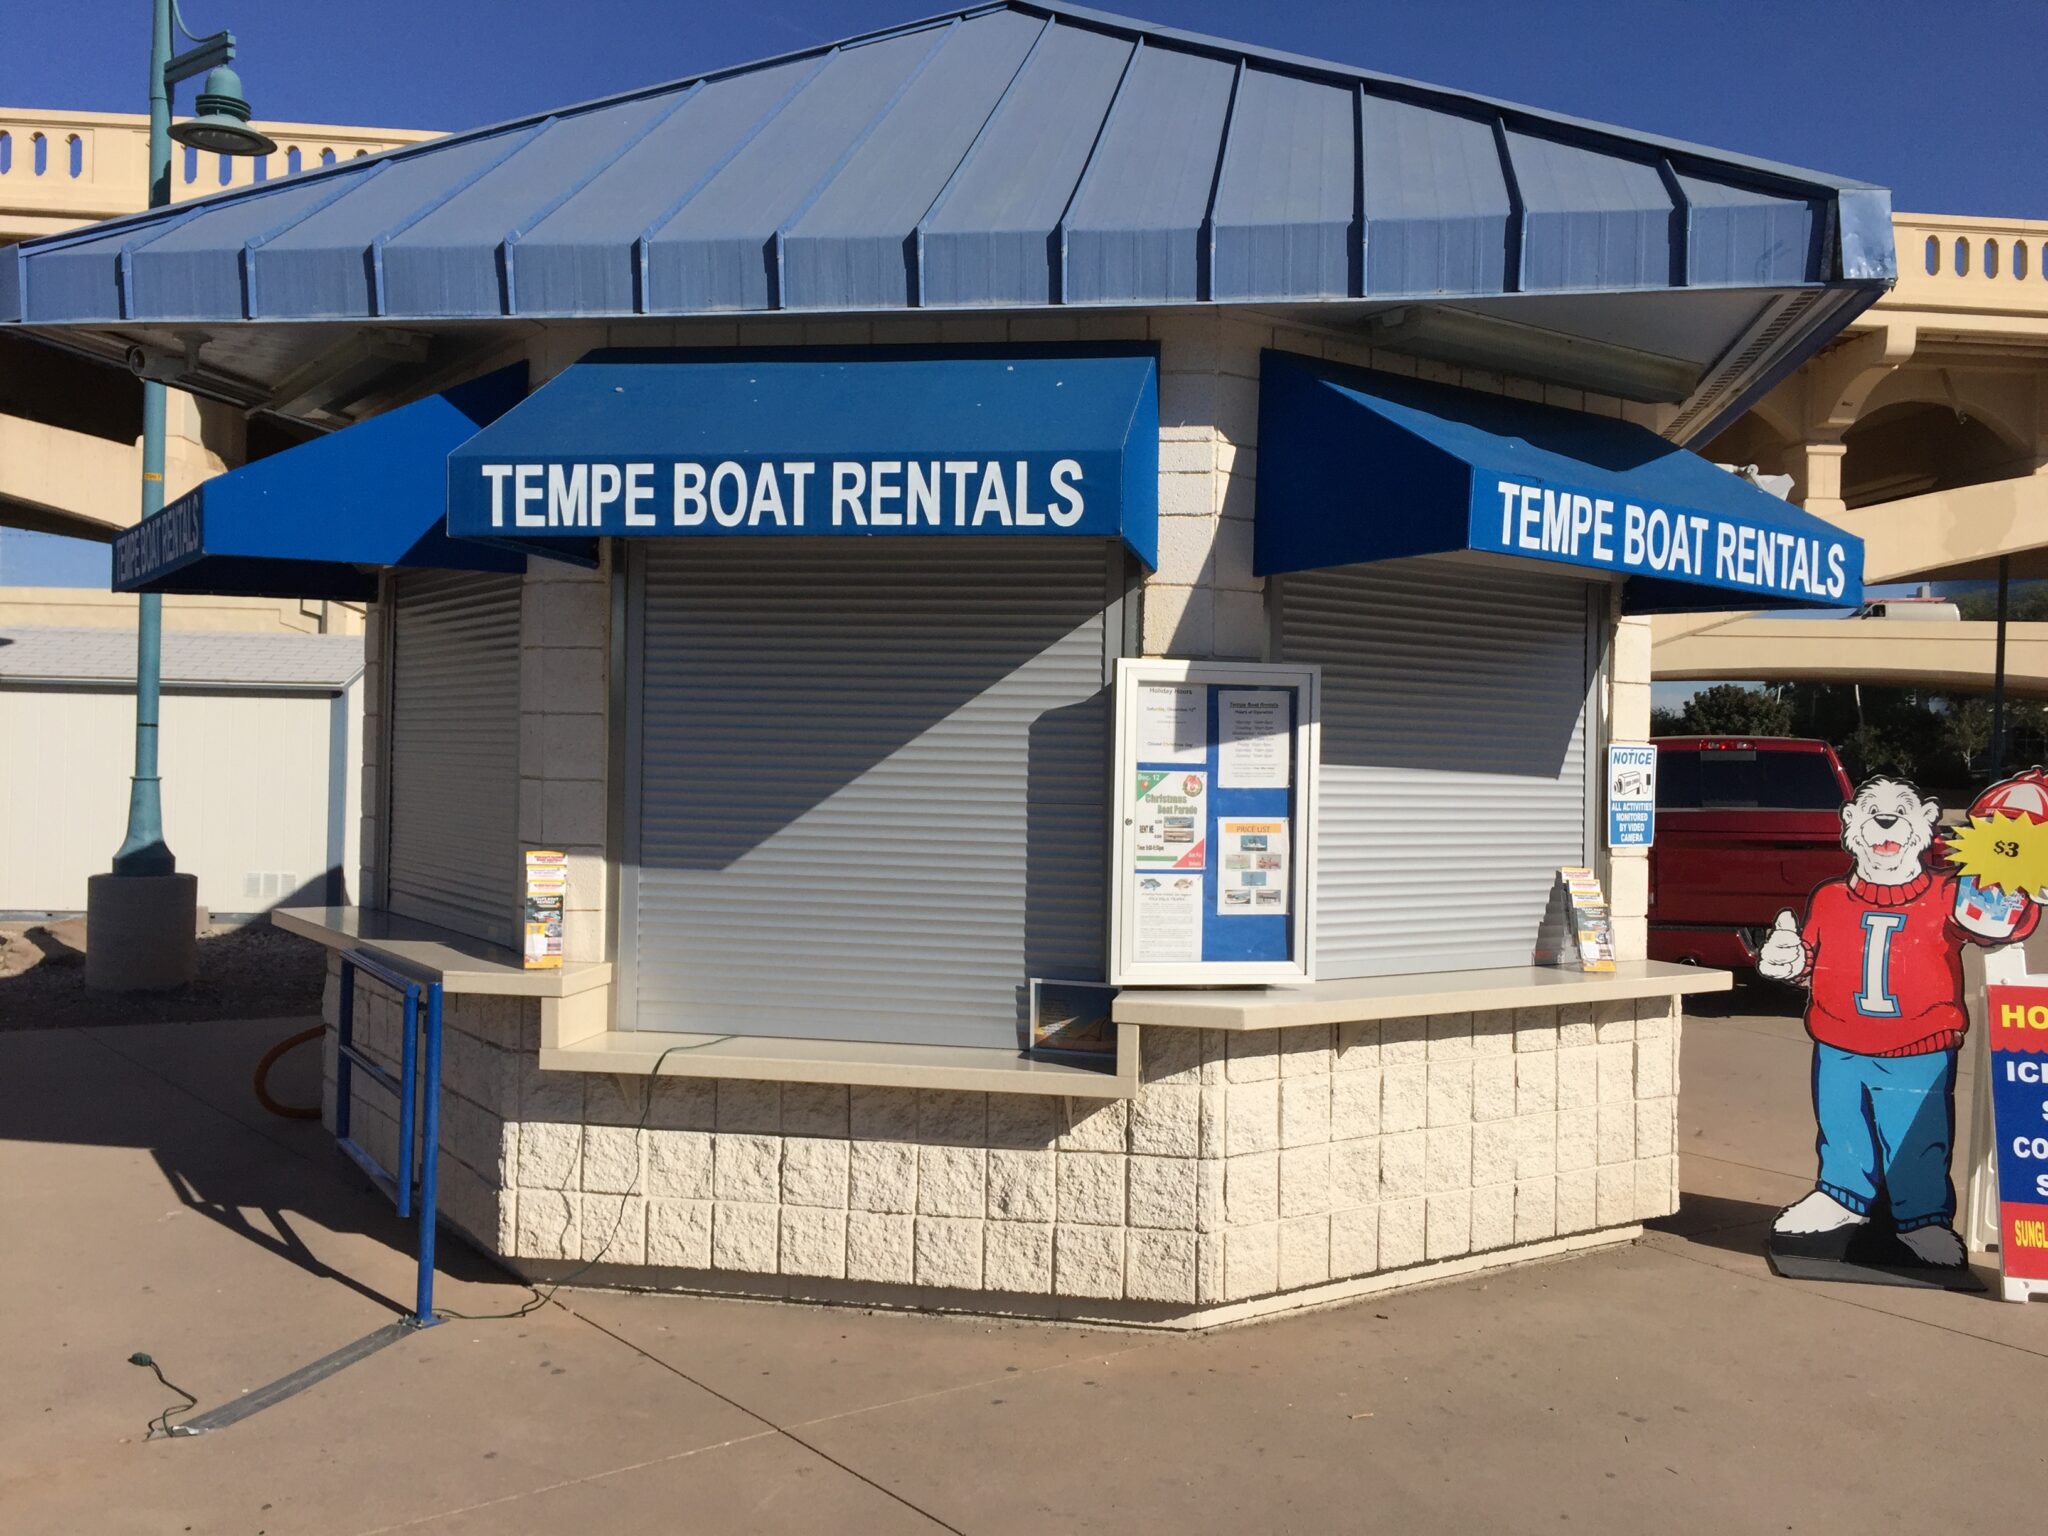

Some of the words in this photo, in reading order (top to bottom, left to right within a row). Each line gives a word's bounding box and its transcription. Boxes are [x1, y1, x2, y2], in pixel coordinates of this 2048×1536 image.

[481, 463, 657, 528] TEMPE
[673, 460, 815, 528] BOAT
[832, 459, 1085, 528] RENTALS
[116, 529, 140, 584] TEMPE
[141, 517, 160, 574] BOAT
[162, 493, 199, 565] RENTALS
[1497, 481, 1614, 562] TEMPE
[1623, 504, 1709, 576] BOAT
[1716, 522, 1846, 599] RENTALS
[1613, 751, 1652, 765] NOTICE
[1145, 793, 1187, 803] Christmas
[1157, 805, 1173, 814] Boat
[1174, 805, 1198, 814] Parade
[1612, 801, 1621, 811] ALL
[1616, 812, 1648, 821] MONITORED
[1619, 822, 1627, 832] BY
[1628, 822, 1645, 832] VIDEO
[1620, 832, 1644, 842] CAMERA
[1993, 840, 2019, 857] $3
[1854, 911, 1907, 1017] I
